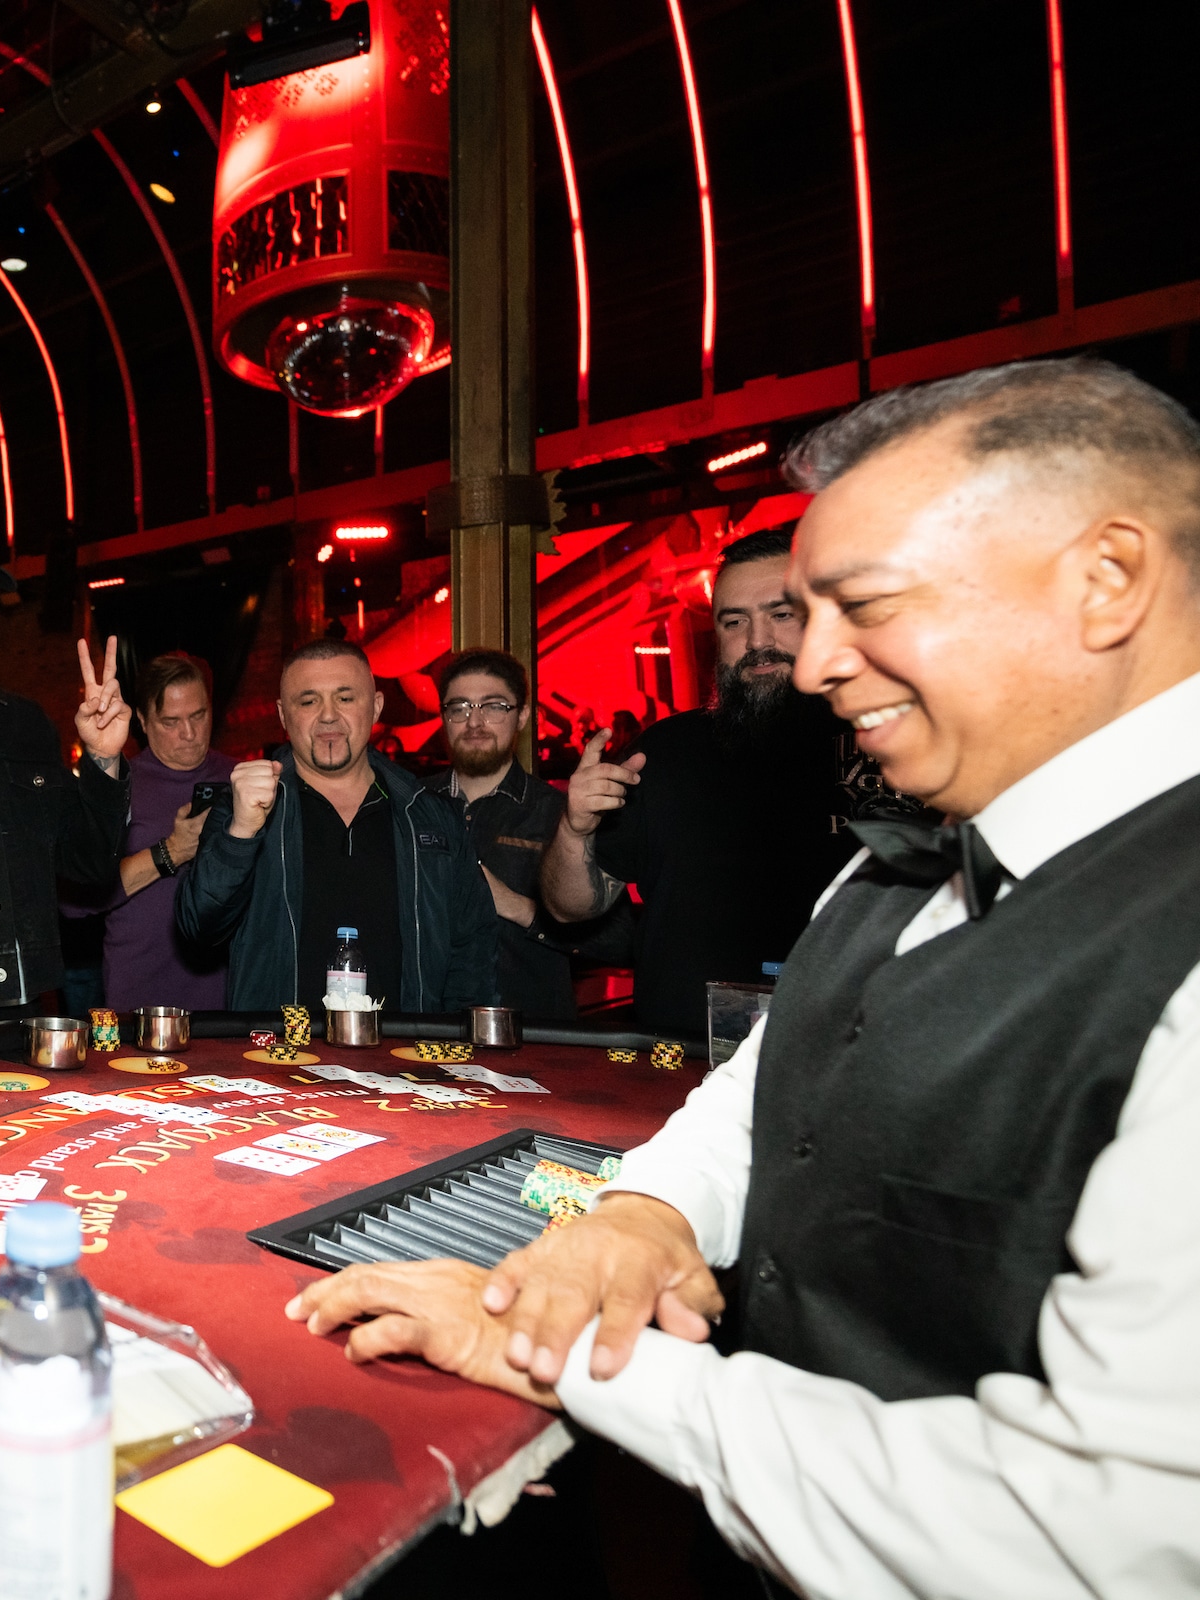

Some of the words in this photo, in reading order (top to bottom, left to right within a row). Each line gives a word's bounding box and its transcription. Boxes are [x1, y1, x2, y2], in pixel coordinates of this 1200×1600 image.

[212, 1095, 285, 1110] draw
[287, 1089, 370, 1100] must
[89, 1120, 143, 1142] and
[94, 1106, 340, 1174] BLACKJACK
[27, 1136, 97, 1172] stand
[63, 1184, 128, 1202] 3
[79, 1202, 119, 1235] PAYS
